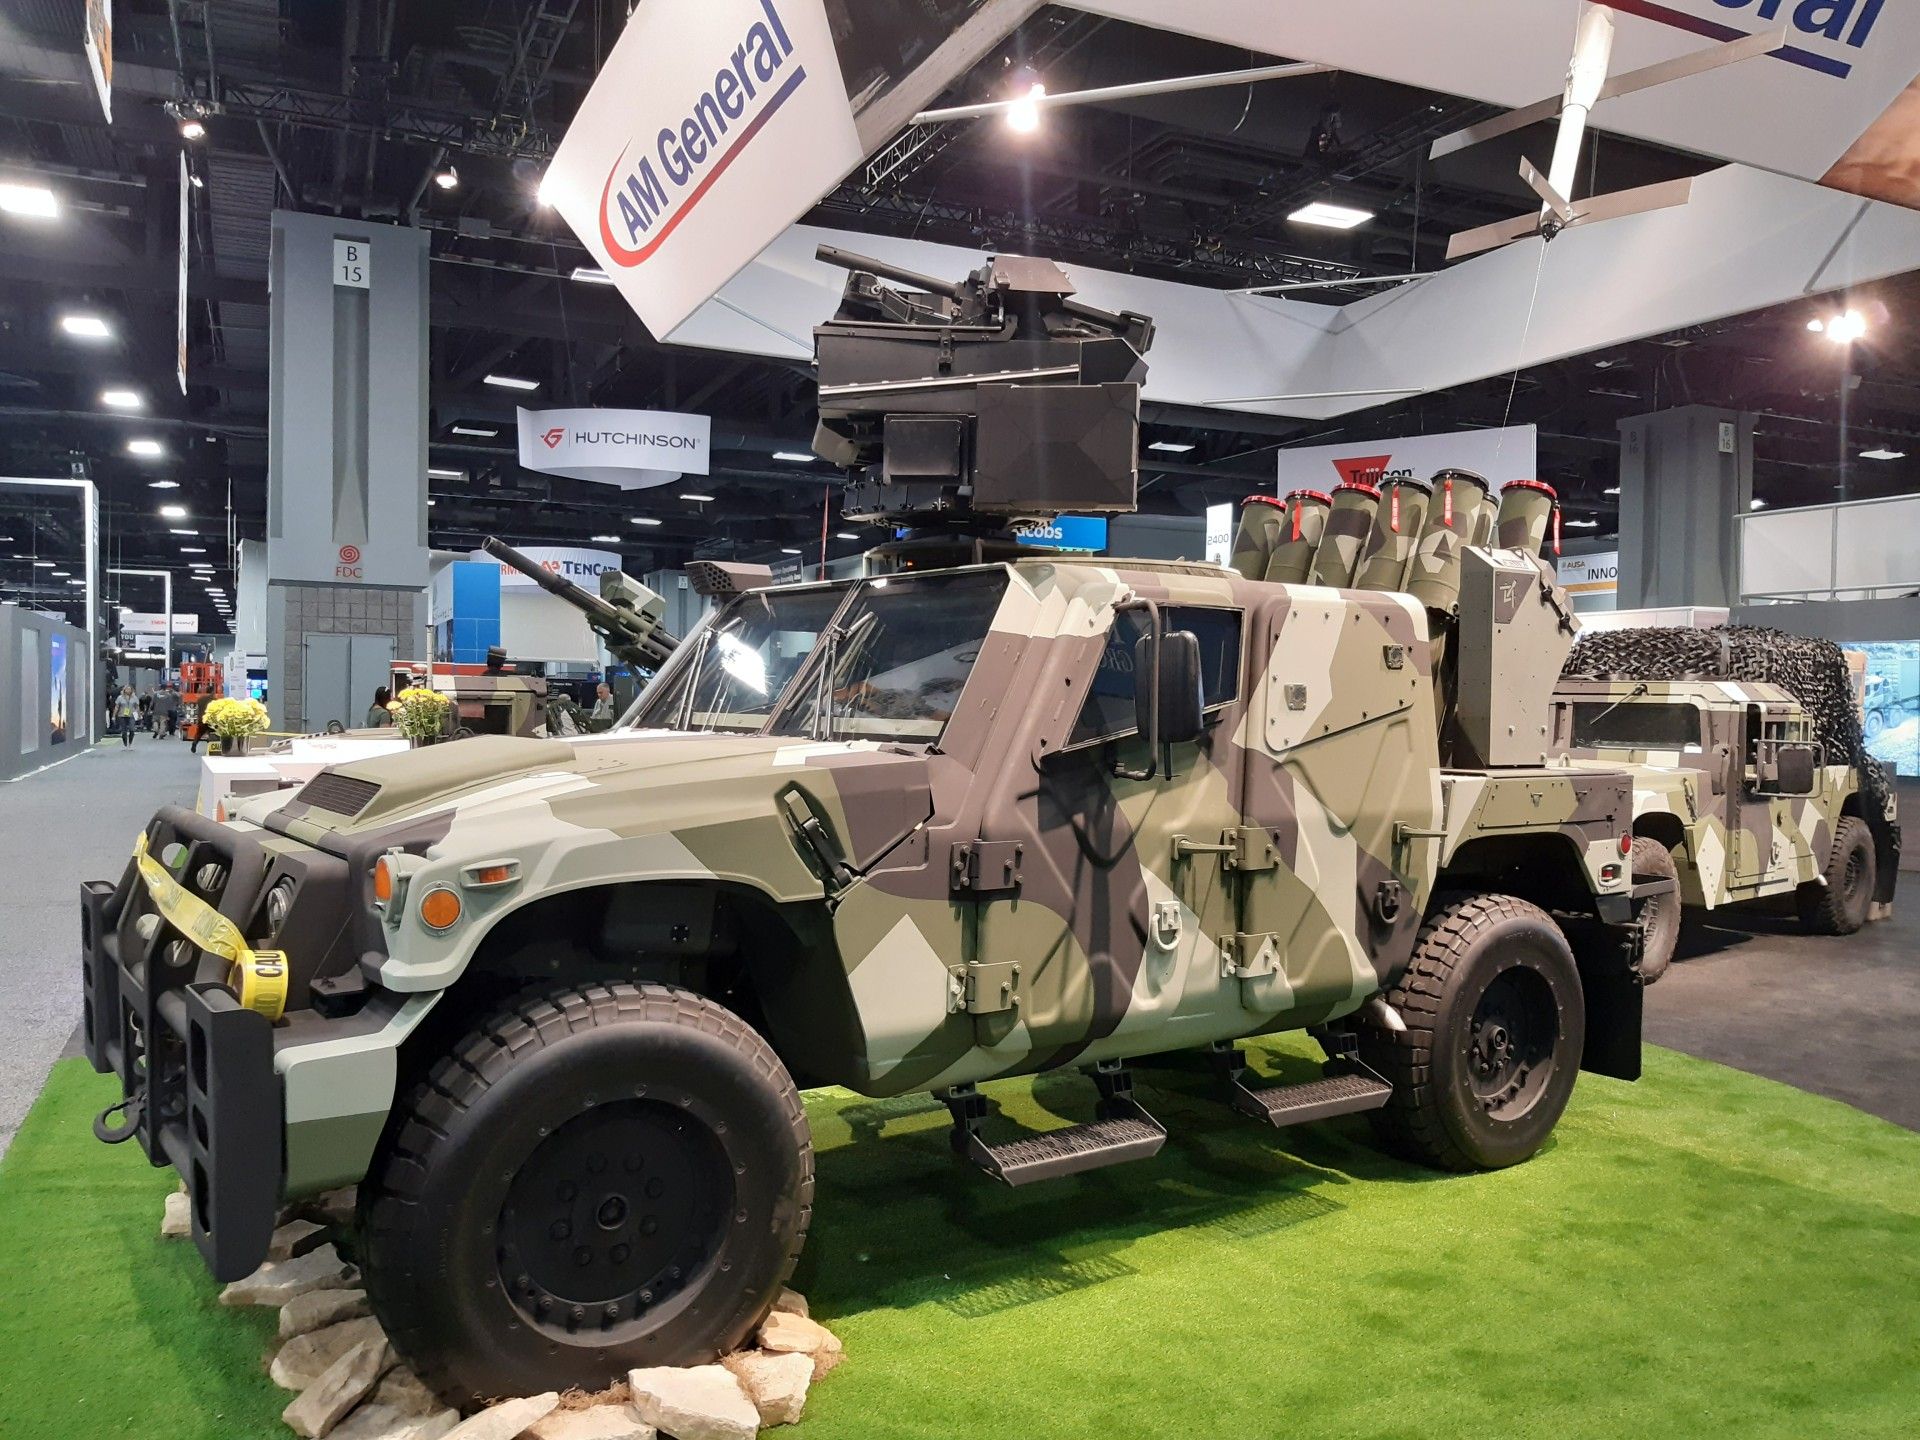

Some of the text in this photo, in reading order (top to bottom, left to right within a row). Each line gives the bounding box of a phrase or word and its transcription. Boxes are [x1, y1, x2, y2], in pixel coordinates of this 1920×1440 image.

[616, 0, 793, 245] AM General
[347, 246, 357, 261] B
[342, 266, 362, 282] 15
[575, 432, 696, 450] HUTCHINSON
[1207, 533, 1230, 546] 2400
[335, 566, 363, 579] FDC
[563, 560, 618, 576] TENCAT
